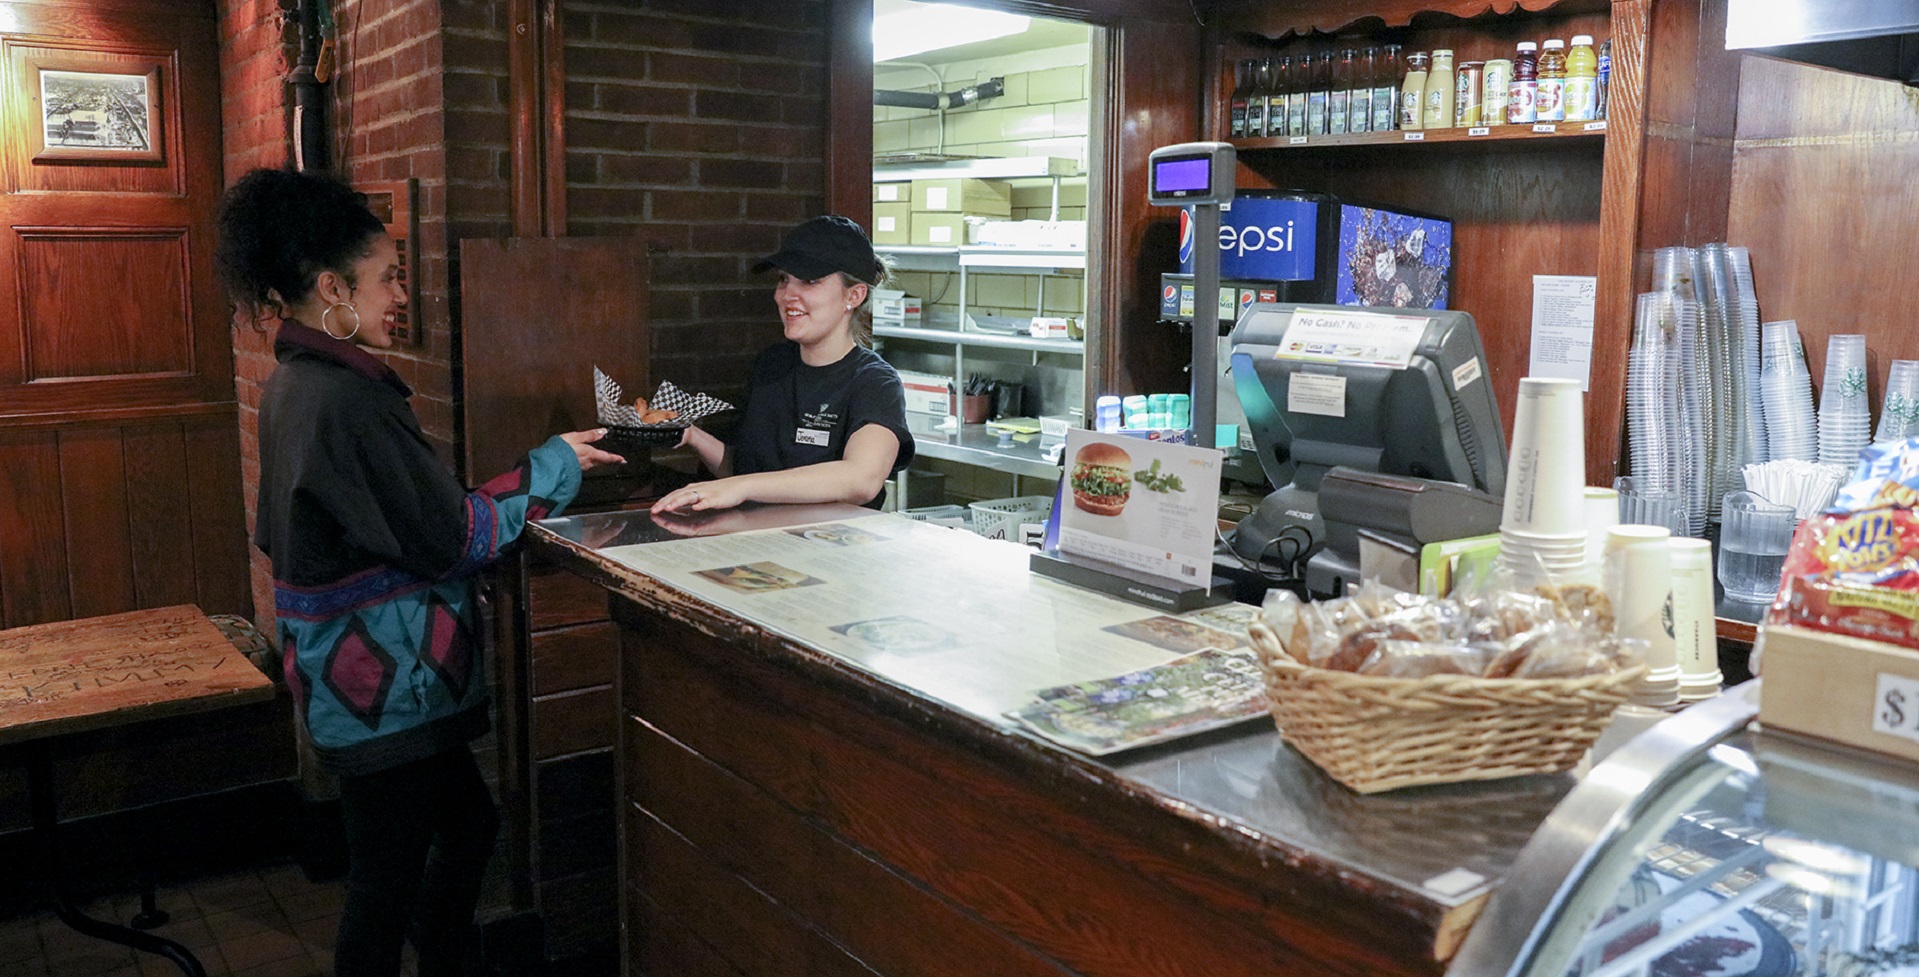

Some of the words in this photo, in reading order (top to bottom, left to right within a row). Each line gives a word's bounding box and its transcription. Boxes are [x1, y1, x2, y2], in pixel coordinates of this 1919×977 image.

[1218, 220, 1294, 257] epsi
[1219, 301, 1234, 309] Mist
[1298, 318, 1313, 327] No
[1315, 318, 1345, 329] Cash?
[1347, 320, 1361, 330] No
